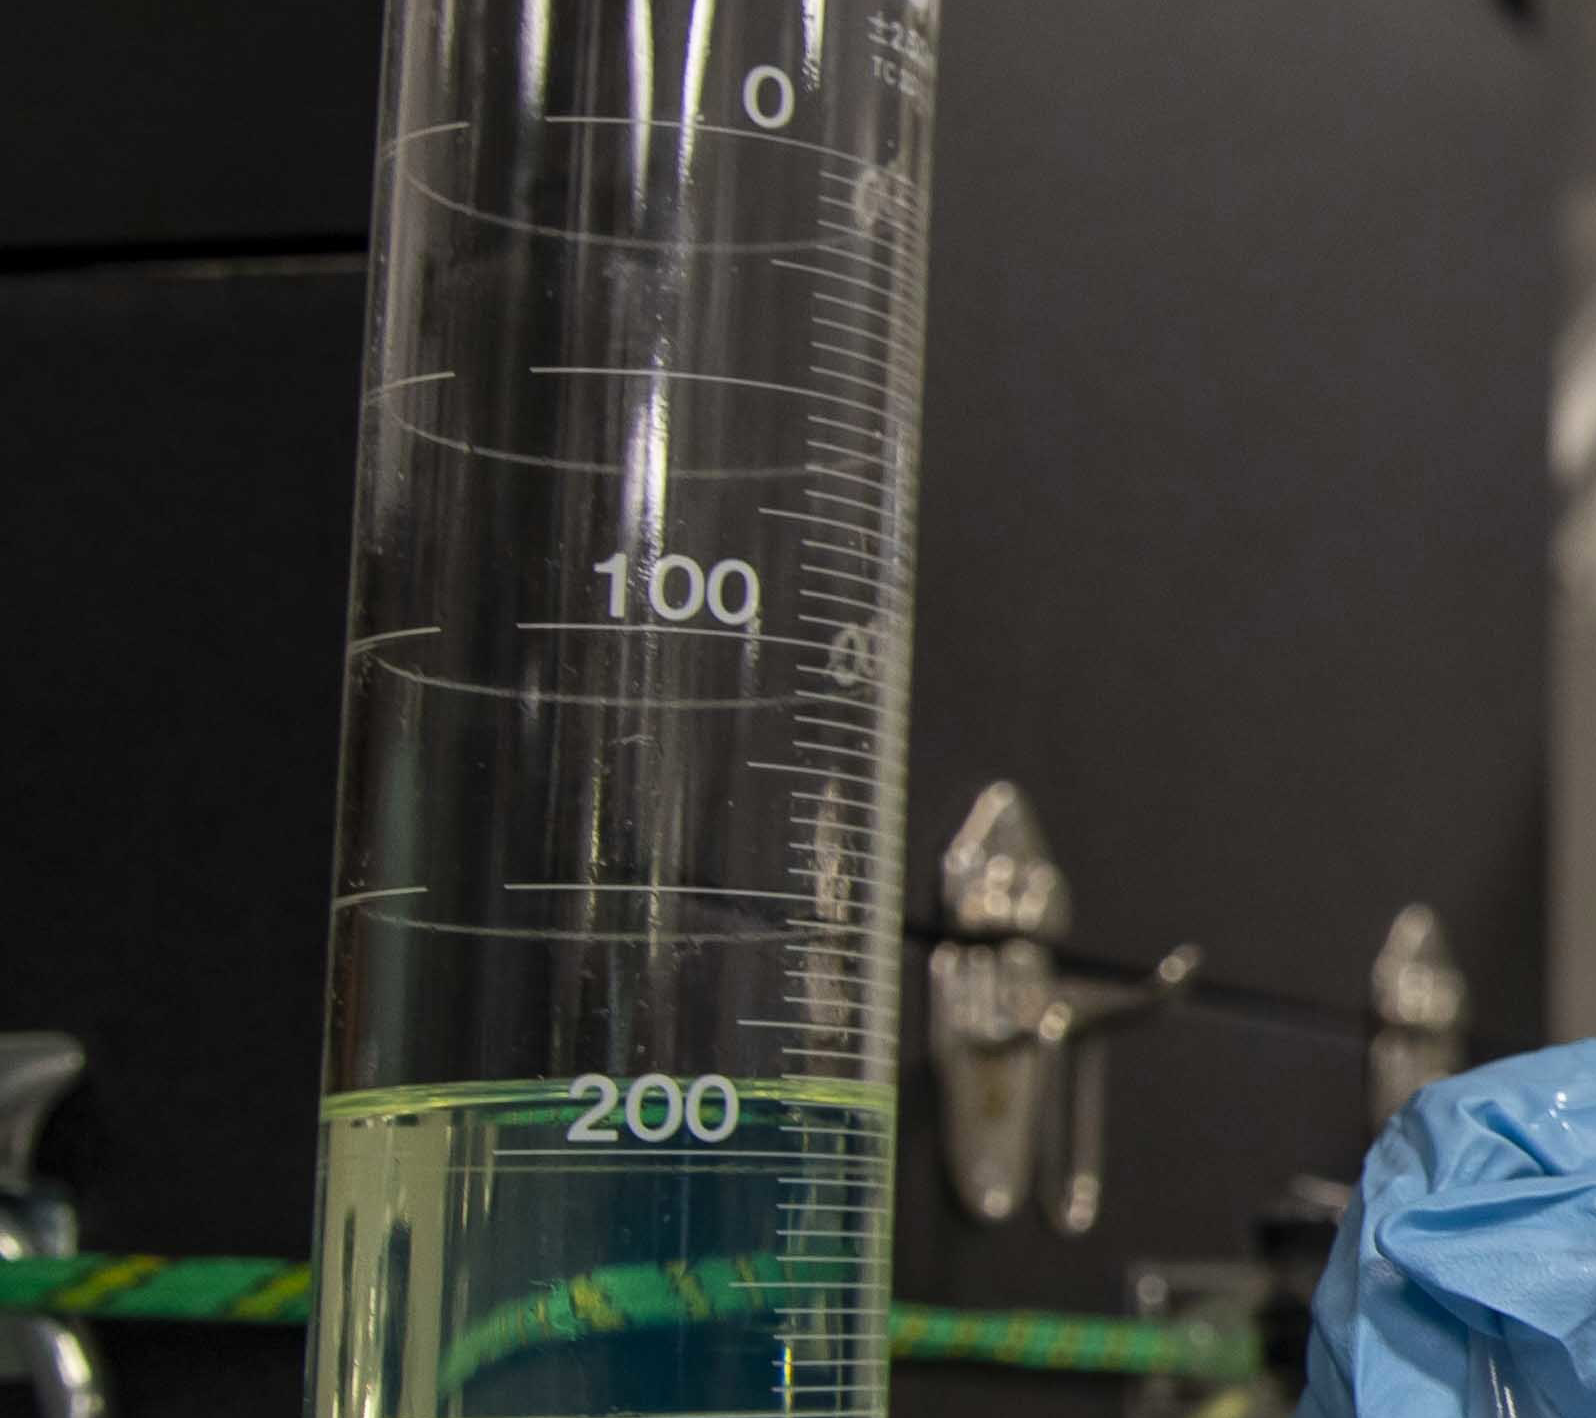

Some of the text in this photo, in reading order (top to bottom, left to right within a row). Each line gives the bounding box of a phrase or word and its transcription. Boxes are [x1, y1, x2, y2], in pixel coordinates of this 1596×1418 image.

[742, 65, 796, 130] 0
[592, 554, 760, 627] 100
[566, 1074, 741, 1145] 200
